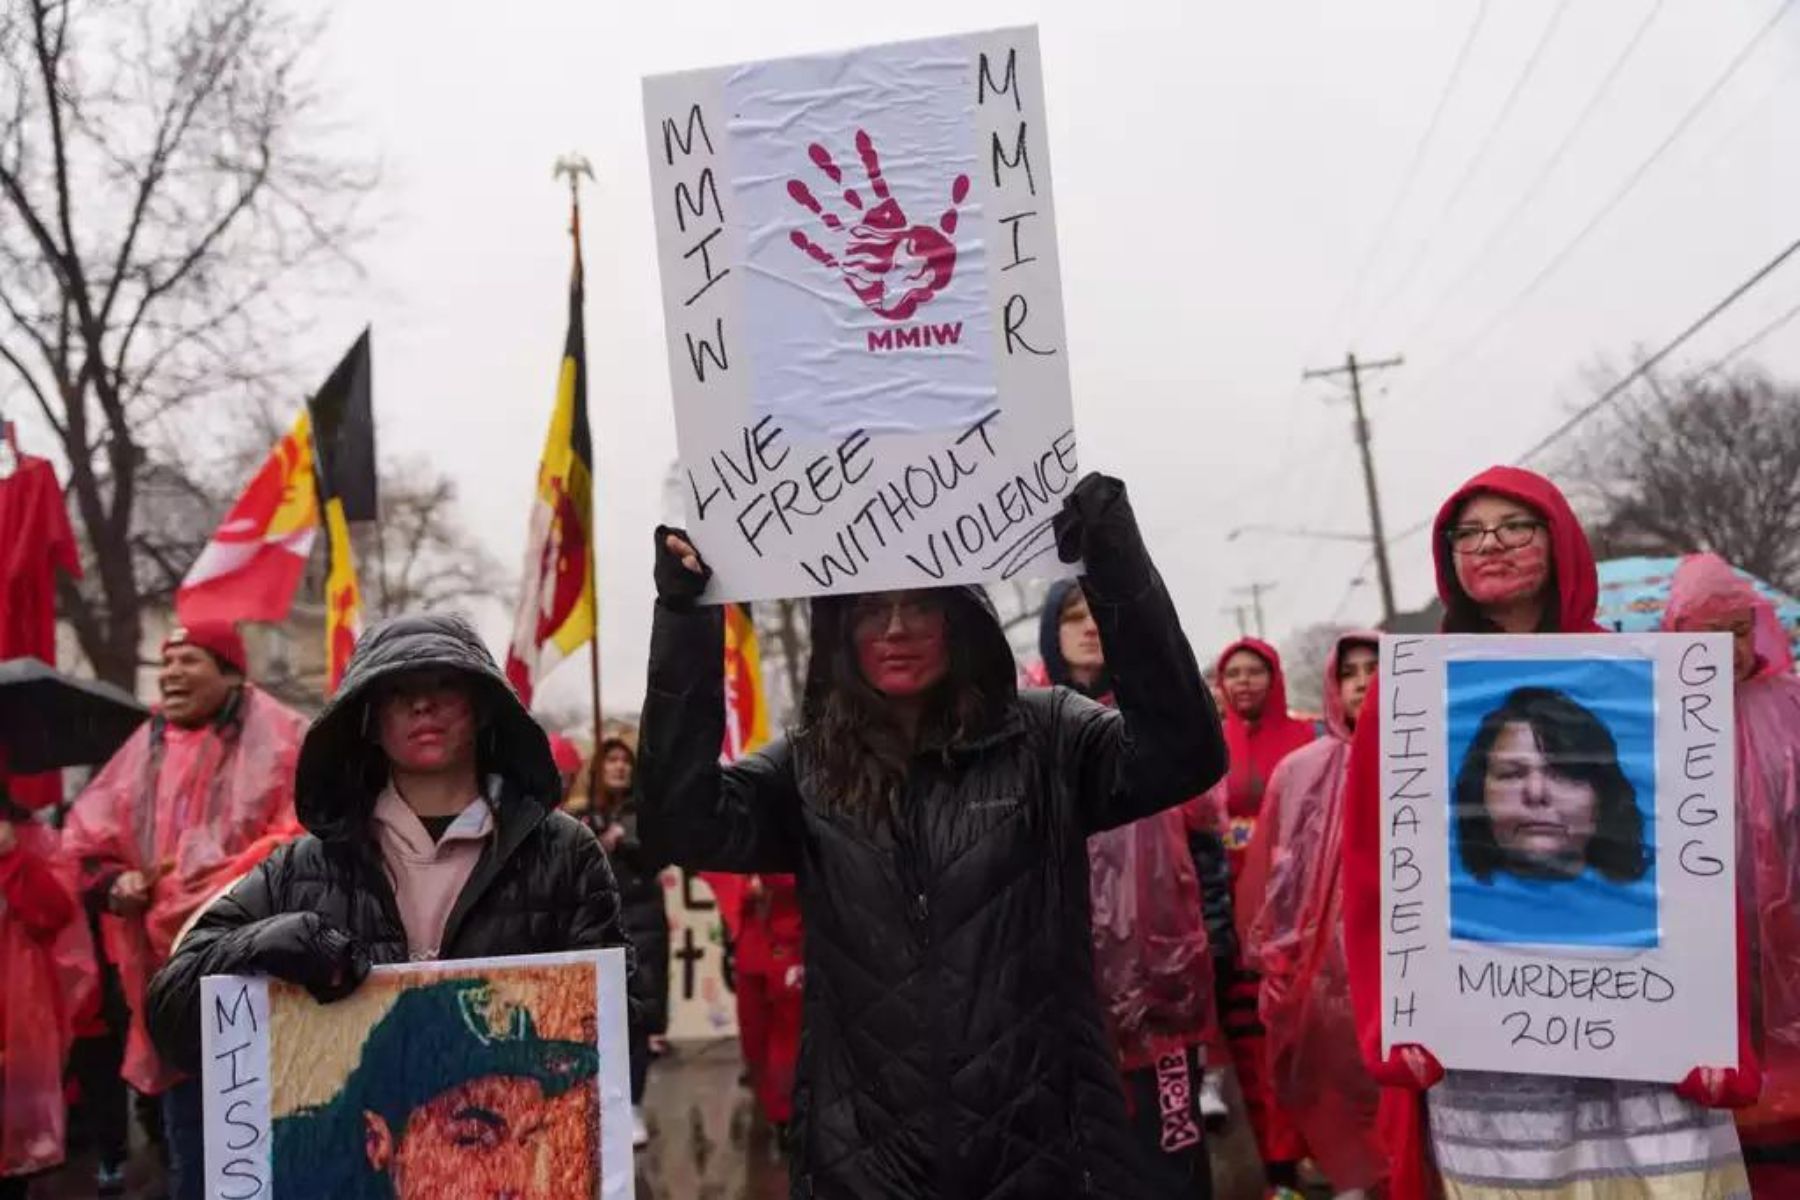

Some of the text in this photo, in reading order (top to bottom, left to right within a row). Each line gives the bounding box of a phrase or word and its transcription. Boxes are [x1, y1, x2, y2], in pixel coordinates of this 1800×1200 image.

[662, 103, 731, 382] MMIW
[977, 47, 1057, 357] MMIR
[866, 321, 963, 352] MMIW
[687, 414, 791, 520] LIVE
[736, 428, 875, 556] FREE
[800, 409, 1002, 588] WITHOUT
[906, 427, 1078, 580] VIOLENCE
[1387, 638, 1431, 1028] ELIZABETH
[1676, 642, 1725, 877] GREGG
[1457, 961, 1675, 1003] MURDERED
[1501, 1011, 1616, 1051] 2015
